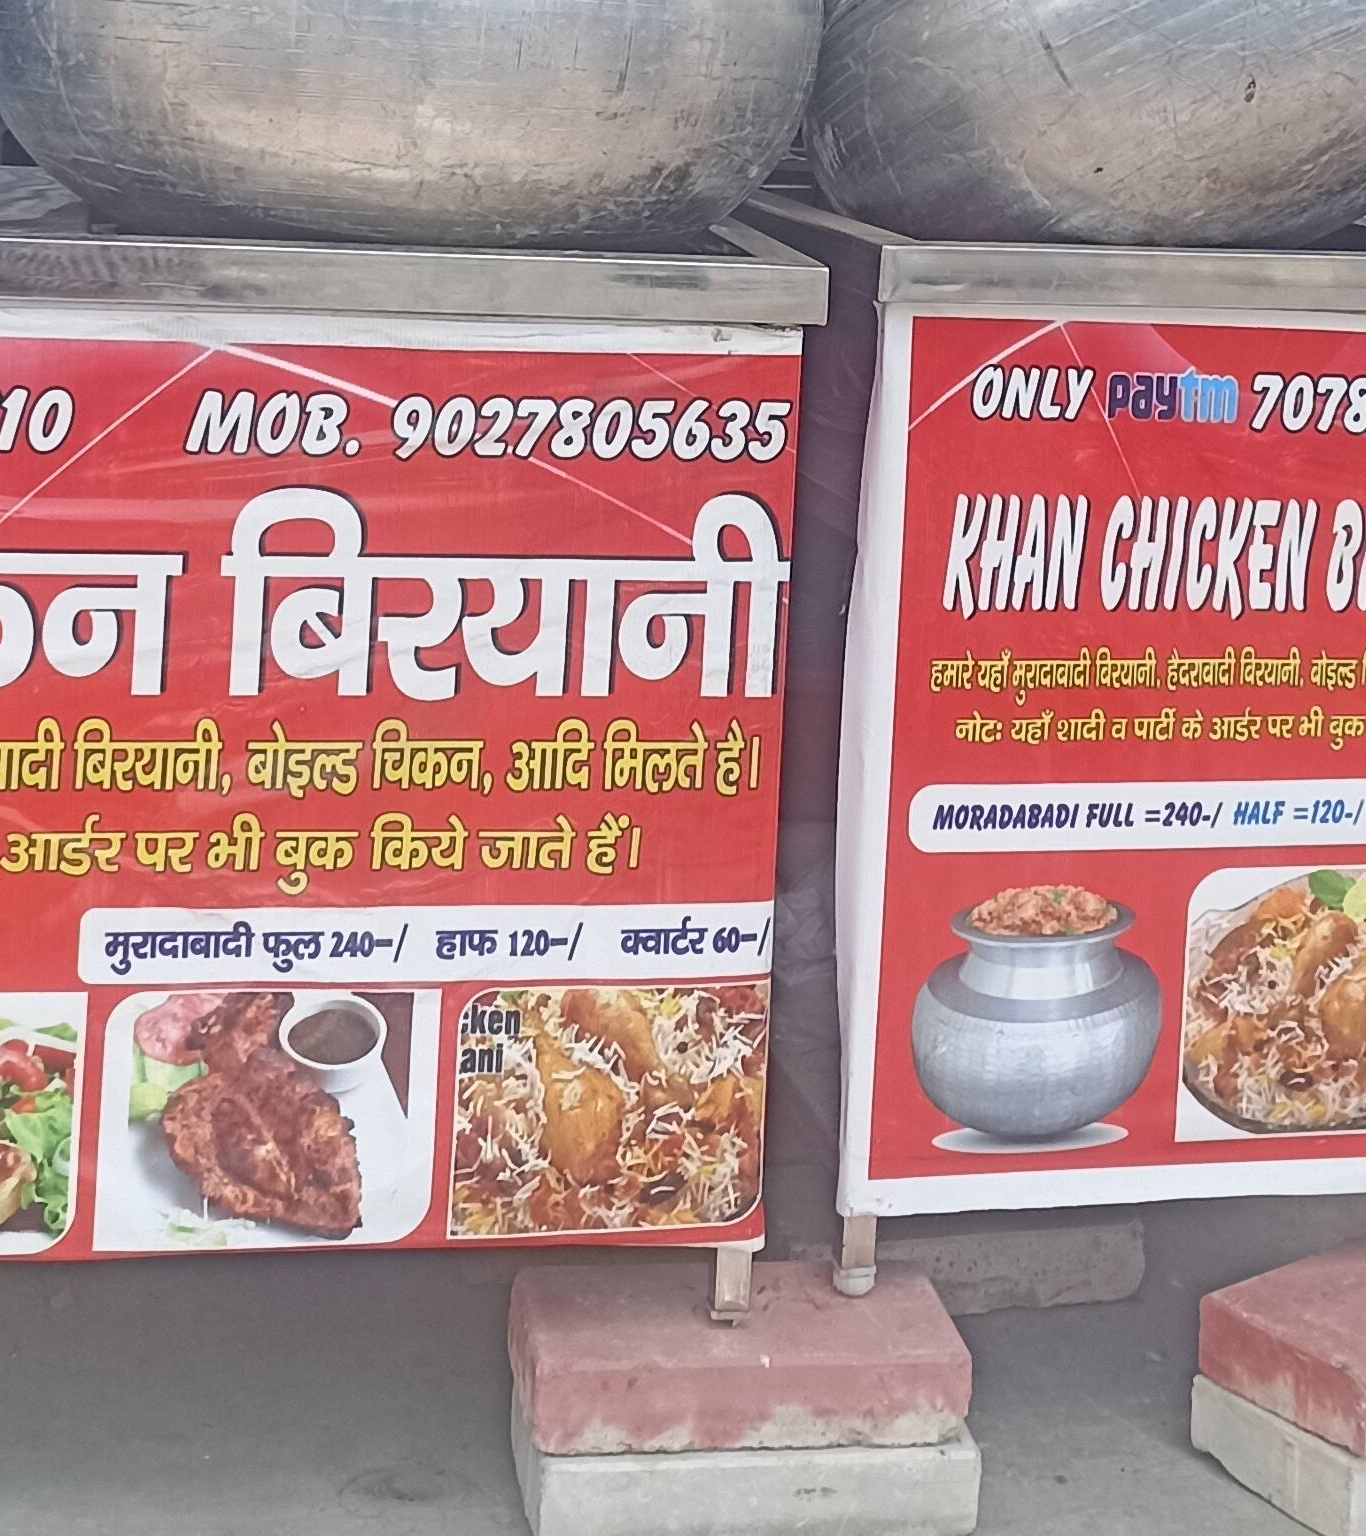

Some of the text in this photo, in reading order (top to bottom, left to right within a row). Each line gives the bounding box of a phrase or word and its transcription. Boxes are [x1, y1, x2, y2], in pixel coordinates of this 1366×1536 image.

[972, 365, 1096, 421] ONLY
[185, 390, 791, 461] MOB. 9027805635
[942, 493, 1090, 620] KHAN
[1100, 495, 1319, 620] CHICKEN
[221, 485, 790, 702] बिरयानी
[930, 649, 974, 692] हमारे
[1057, 708, 1105, 742] शादी
[1111, 717, 1128, 740] व
[1134, 708, 1176, 741] पार्टी
[1181, 710, 1203, 740] के
[1267, 716, 1295, 739] पर
[1299, 705, 1325, 737] भी
[74, 717, 232, 796] बिरयानी,
[247, 721, 363, 799] बोइल्ड
[373, 718, 494, 797] चिकन,
[506, 718, 596, 790] आदि
[602, 719, 707, 795] मिलते
[933, 803, 1079, 830] MORADABADI
[1086, 803, 1135, 828] FULL
[1234, 800, 1285, 826] HALF
[0, 814, 126, 877] आर्डर
[135, 832, 199, 873] पर
[207, 813, 265, 871] भी
[276, 830, 360, 896] बुक
[371, 811, 467, 871] किये
[478, 814, 575, 871] जाते
[104, 920, 254, 975] मुरादाबादी
[262, 927, 322, 974] फुल
[435, 927, 499, 960] हाफ
[620, 919, 708, 957] क्वार्टर
